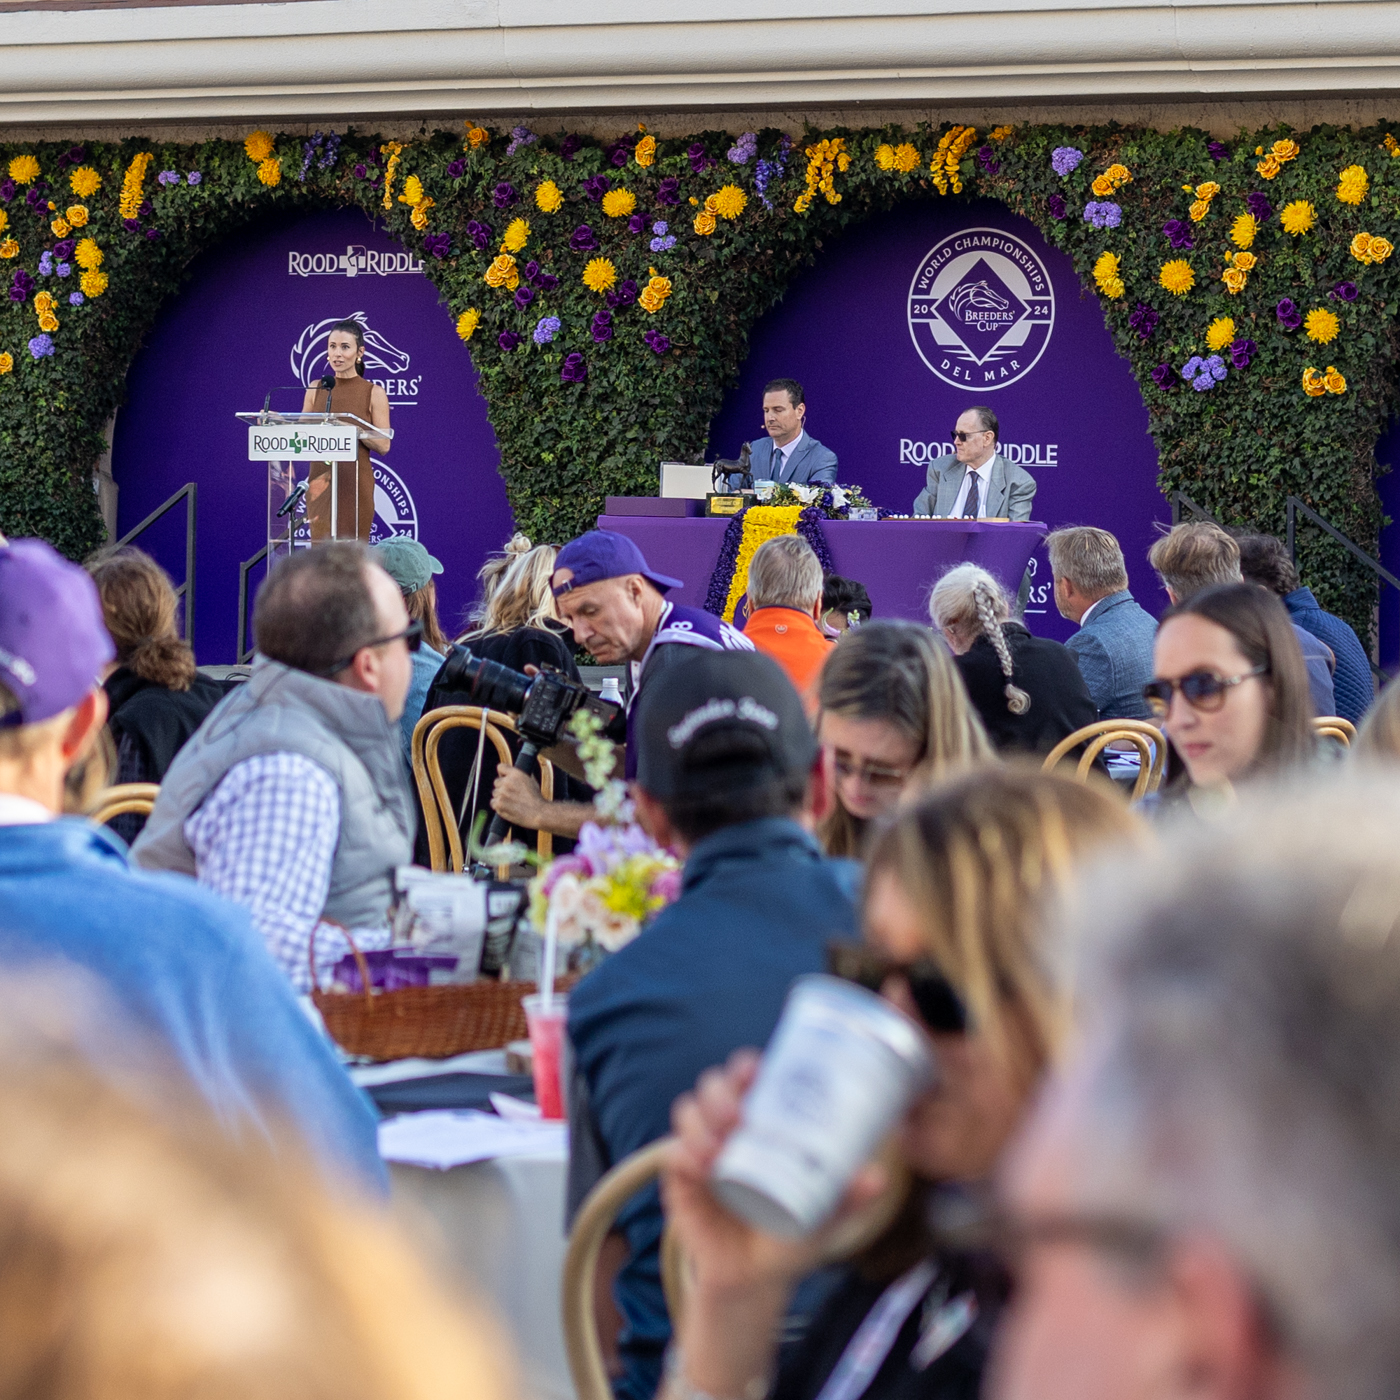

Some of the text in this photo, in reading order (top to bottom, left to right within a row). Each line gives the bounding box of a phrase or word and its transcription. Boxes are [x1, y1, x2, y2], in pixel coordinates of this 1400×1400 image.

[288, 252, 338, 277] ROOD
[918, 236, 1045, 291] WORLD CHAMPIONSHIPS
[914, 305, 928, 313] 20
[965, 310, 1015, 321] BREEDERS'
[1034, 306, 1048, 315] 24
[977, 321, 999, 332] CUP
[941, 359, 1021, 381] DEL MAR
[368, 375, 423, 396] DERS'
[254, 435, 351, 453] ROOD RIDDLE
[900, 439, 956, 466] ROOD
[400, 529, 412, 538] 24
